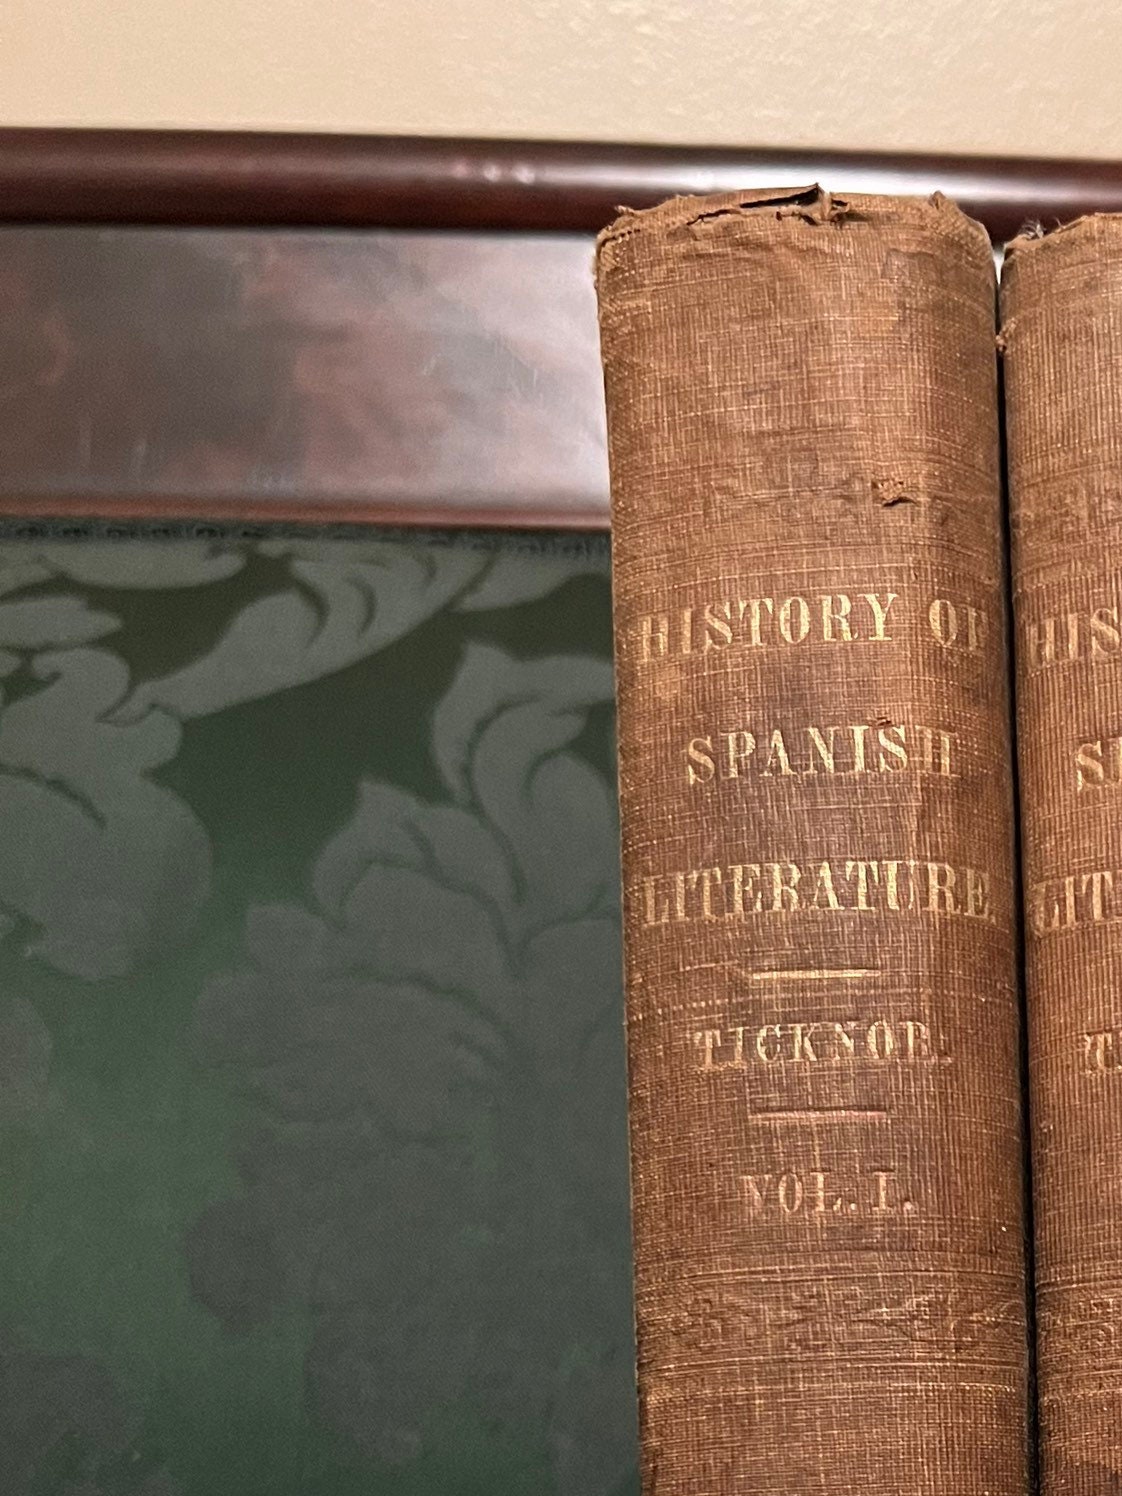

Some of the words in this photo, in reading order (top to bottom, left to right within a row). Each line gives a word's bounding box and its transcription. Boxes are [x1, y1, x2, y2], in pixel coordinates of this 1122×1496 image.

[635, 593, 898, 664] HISTORY
[684, 725, 962, 785] SPANISH
[738, 1171, 857, 1214] VOL.
